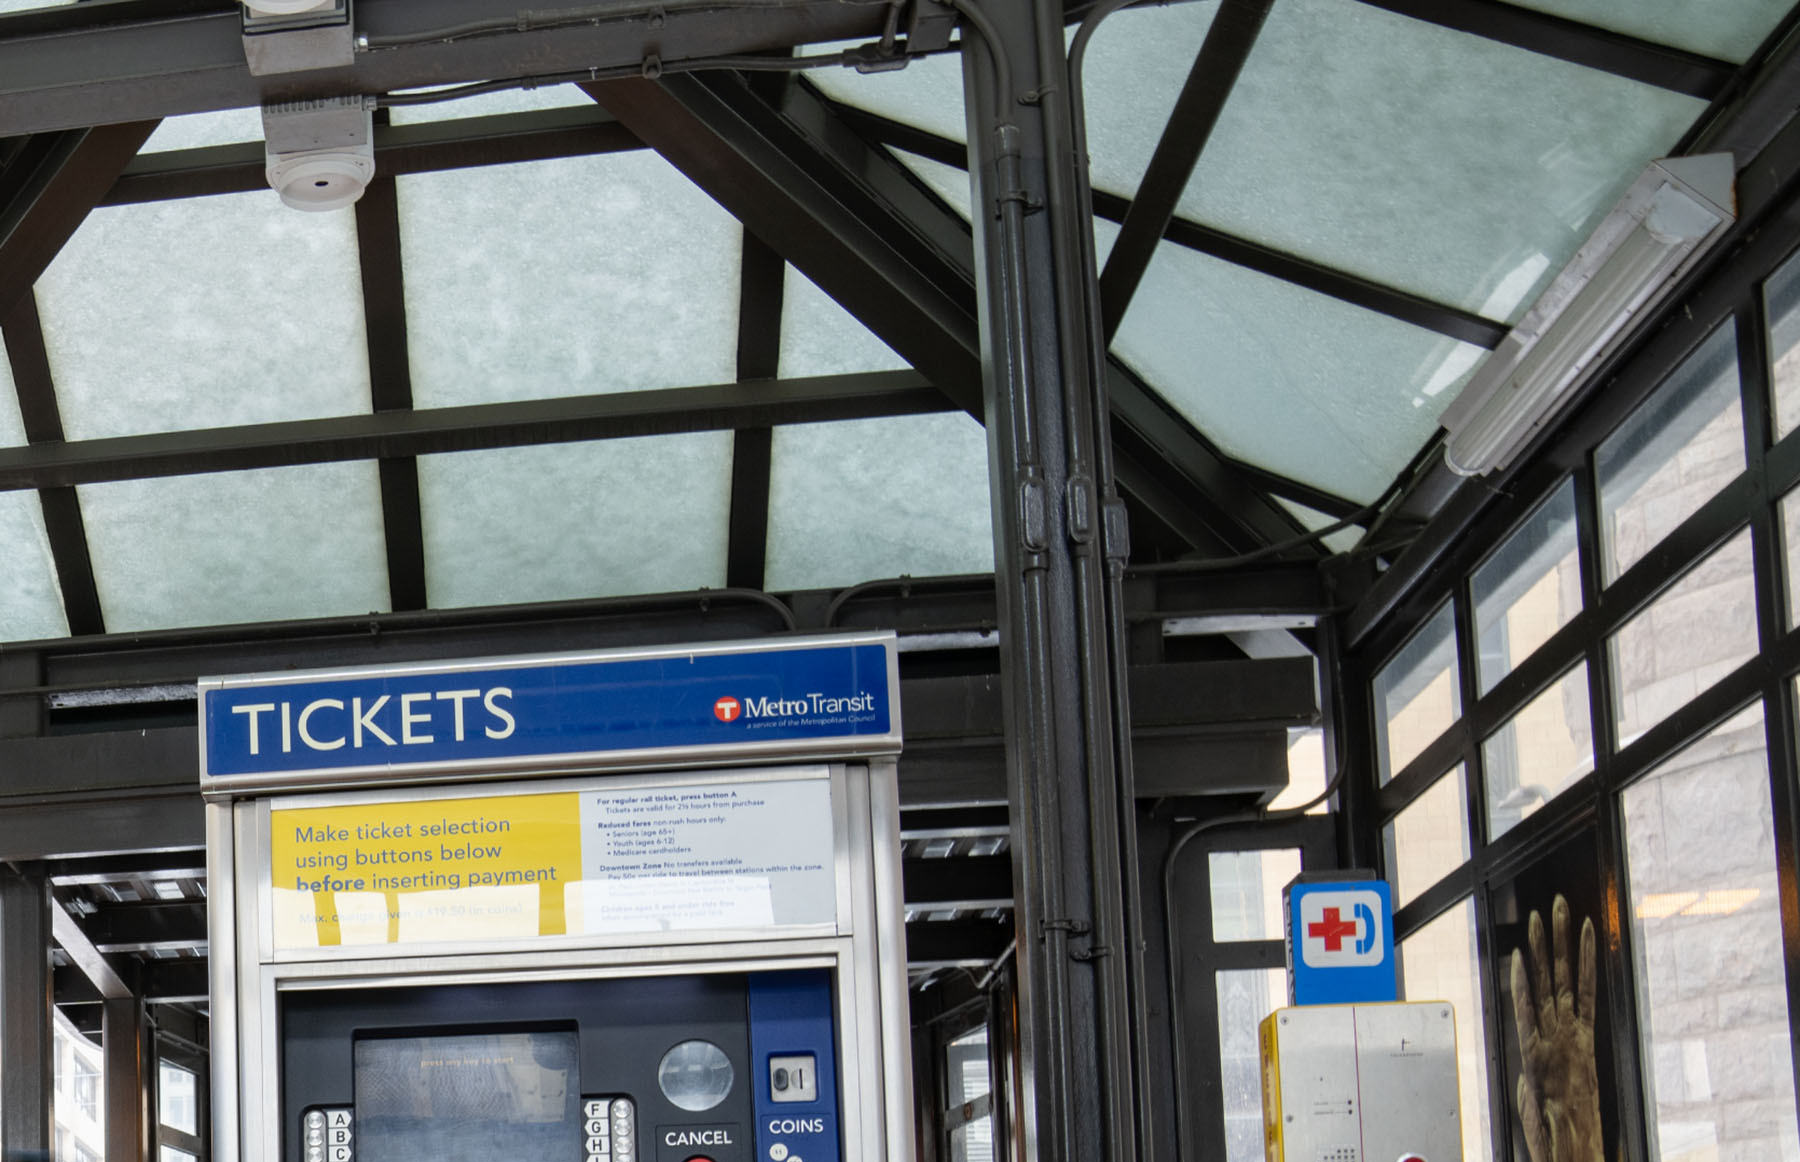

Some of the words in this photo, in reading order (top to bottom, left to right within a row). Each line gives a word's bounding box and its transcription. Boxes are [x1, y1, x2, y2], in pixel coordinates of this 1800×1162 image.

[231, 686, 516, 756] TICKETS
[752, 720, 777, 728] service
[778, 718, 787, 727] of
[788, 717, 800, 726] the
[801, 715, 847, 727] Metropolitan
[848, 713, 876, 722] Council
[612, 797, 638, 805] regular
[655, 794, 678, 802] ticket,
[681, 793, 700, 801] press
[703, 791, 729, 799] button
[606, 806, 631, 814] Tickets
[646, 804, 663, 812] valid
[691, 801, 711, 809] hours
[713, 800, 730, 808] from
[732, 799, 765, 809] purchase
[598, 821, 631, 829] Reduced
[686, 816, 707, 824] hours
[295, 825, 349, 843] Make
[357, 821, 413, 840] ticket
[420, 817, 510, 837] selection
[612, 830, 639, 838] Seniors
[641, 829, 657, 838] (age
[658, 828, 676, 836] 65+)
[636, 839, 654, 848] (ages
[648, 846, 691, 854] cardholders
[296, 851, 348, 871] using
[356, 846, 433, 866] buttons
[440, 842, 502, 861] below
[677, 859, 708, 868] transfers
[711, 857, 742, 866] available
[678, 869, 699, 877] travel
[790, 863, 801, 871] the
[296, 874, 365, 893] before
[373, 870, 461, 890] inserting
[468, 865, 557, 887] payment
[421, 1058, 444, 1069] press
[463, 1055, 479, 1067] key
[494, 1055, 515, 1064] start
[591, 1104, 599, 1116] F
[335, 1114, 346, 1126] A
[769, 1118, 824, 1134] COINS
[591, 1121, 601, 1133] G
[336, 1131, 345, 1143] B
[665, 1130, 733, 1146] CANCEL
[592, 1139, 602, 1151] H
[336, 1148, 346, 1160] C
